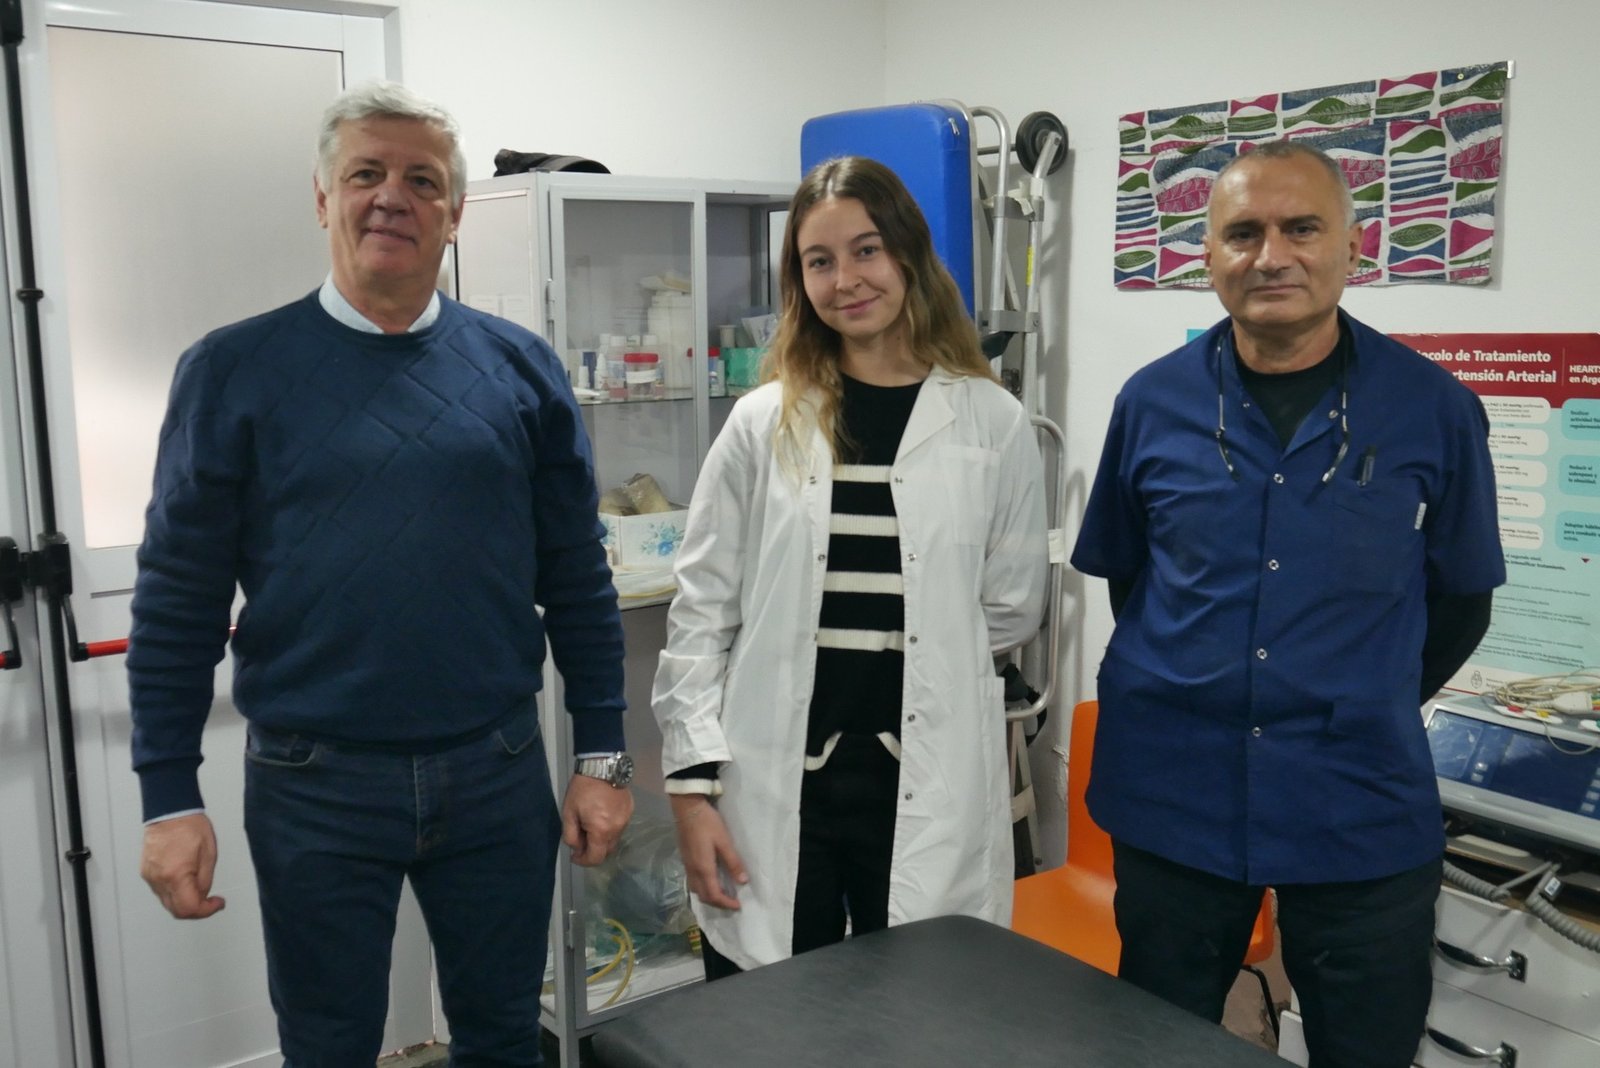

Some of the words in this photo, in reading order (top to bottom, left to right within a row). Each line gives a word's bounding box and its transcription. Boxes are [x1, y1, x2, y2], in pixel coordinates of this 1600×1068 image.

[1416, 349, 1453, 362] ocolo
[1455, 349, 1471, 362] de
[1473, 350, 1551, 363] Tratamiento
[1452, 368, 1504, 382] rtensión
[1506, 370, 1557, 383] Arterial
[1582, 375, 1600, 386] Arge
